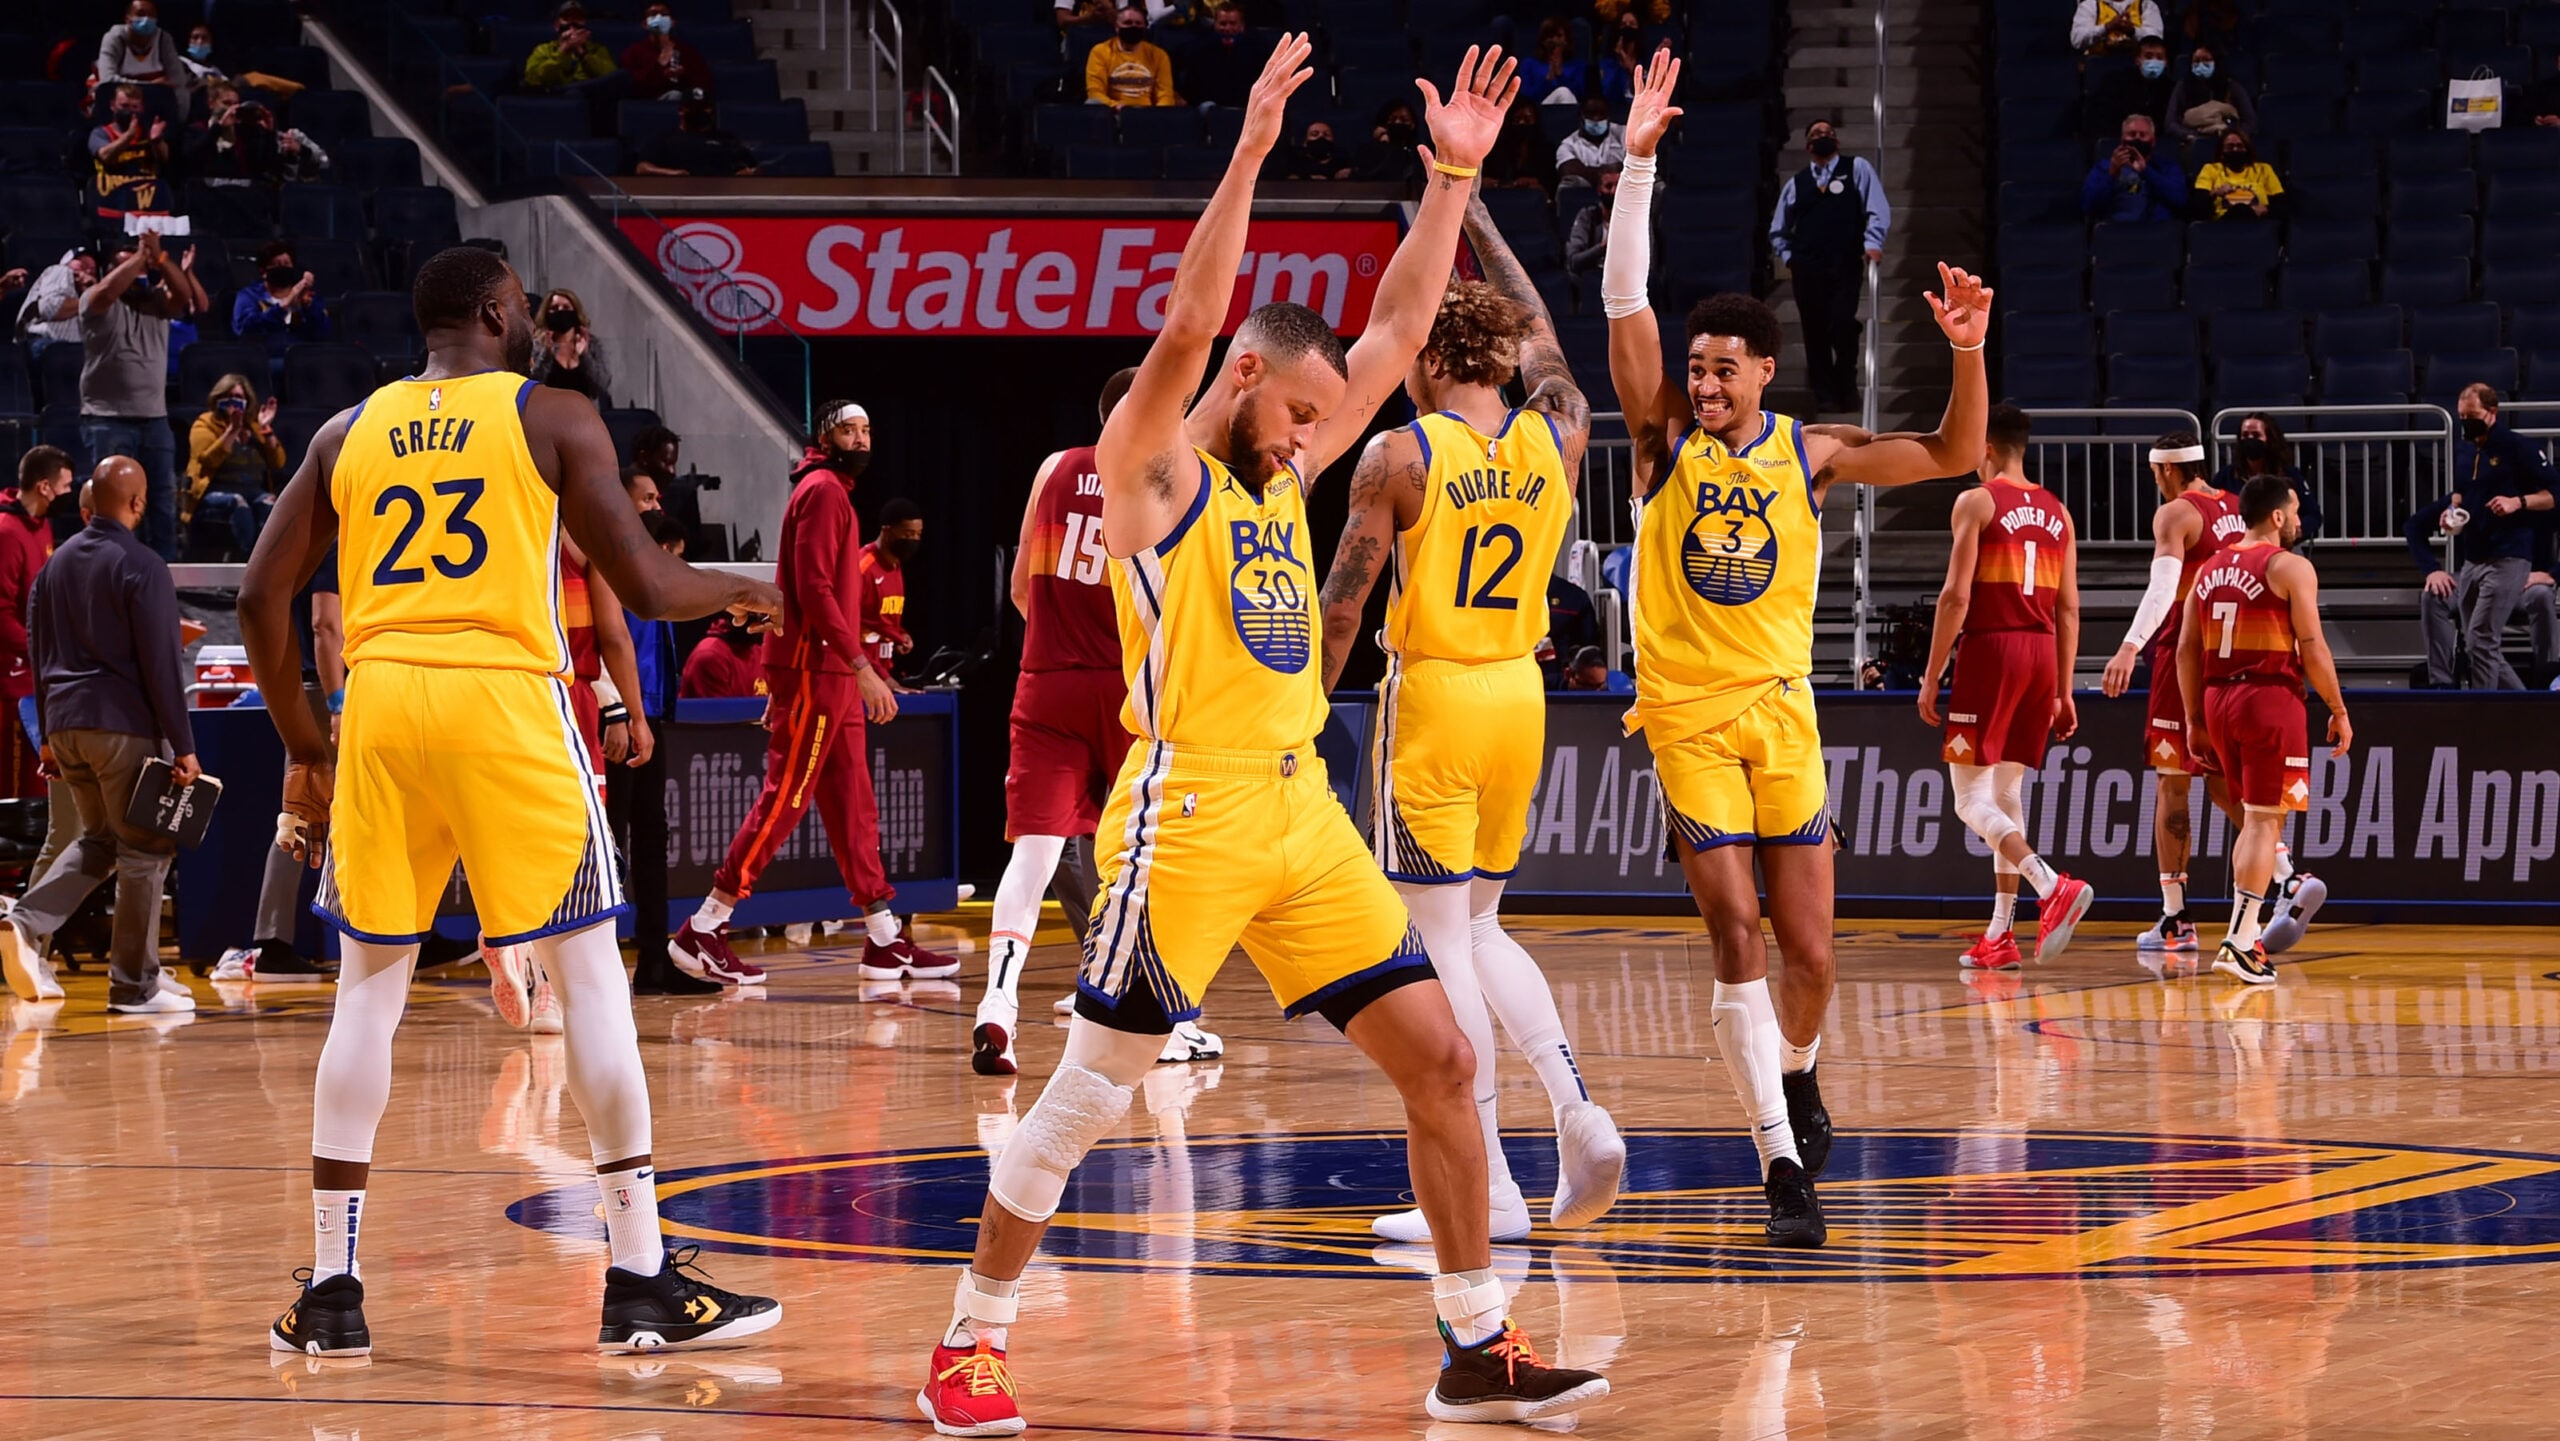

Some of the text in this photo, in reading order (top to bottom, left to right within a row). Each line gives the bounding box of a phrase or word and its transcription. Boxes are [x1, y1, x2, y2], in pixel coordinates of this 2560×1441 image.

[389, 418, 475, 458] GREEN
[1726, 471, 1751, 486] The
[1753, 457, 1791, 467] Rakuten
[1446, 469, 1546, 511] OUBRE JR.
[1696, 482, 1780, 518] BAY
[373, 478, 488, 587] 23
[1230, 520, 1295, 562] BAY
[1721, 520, 1744, 554] 3
[2000, 506, 2064, 541] PORTER JR.
[1056, 511, 1107, 585] 15
[1454, 523, 1524, 610] 12
[2022, 540, 2037, 596] 1
[1253, 570, 1300, 610] 30
[2196, 567, 2265, 601] CAMPAZZO
[2212, 602, 2238, 659] 7
[1823, 746, 1944, 858] The
[2414, 747, 2560, 882] App
